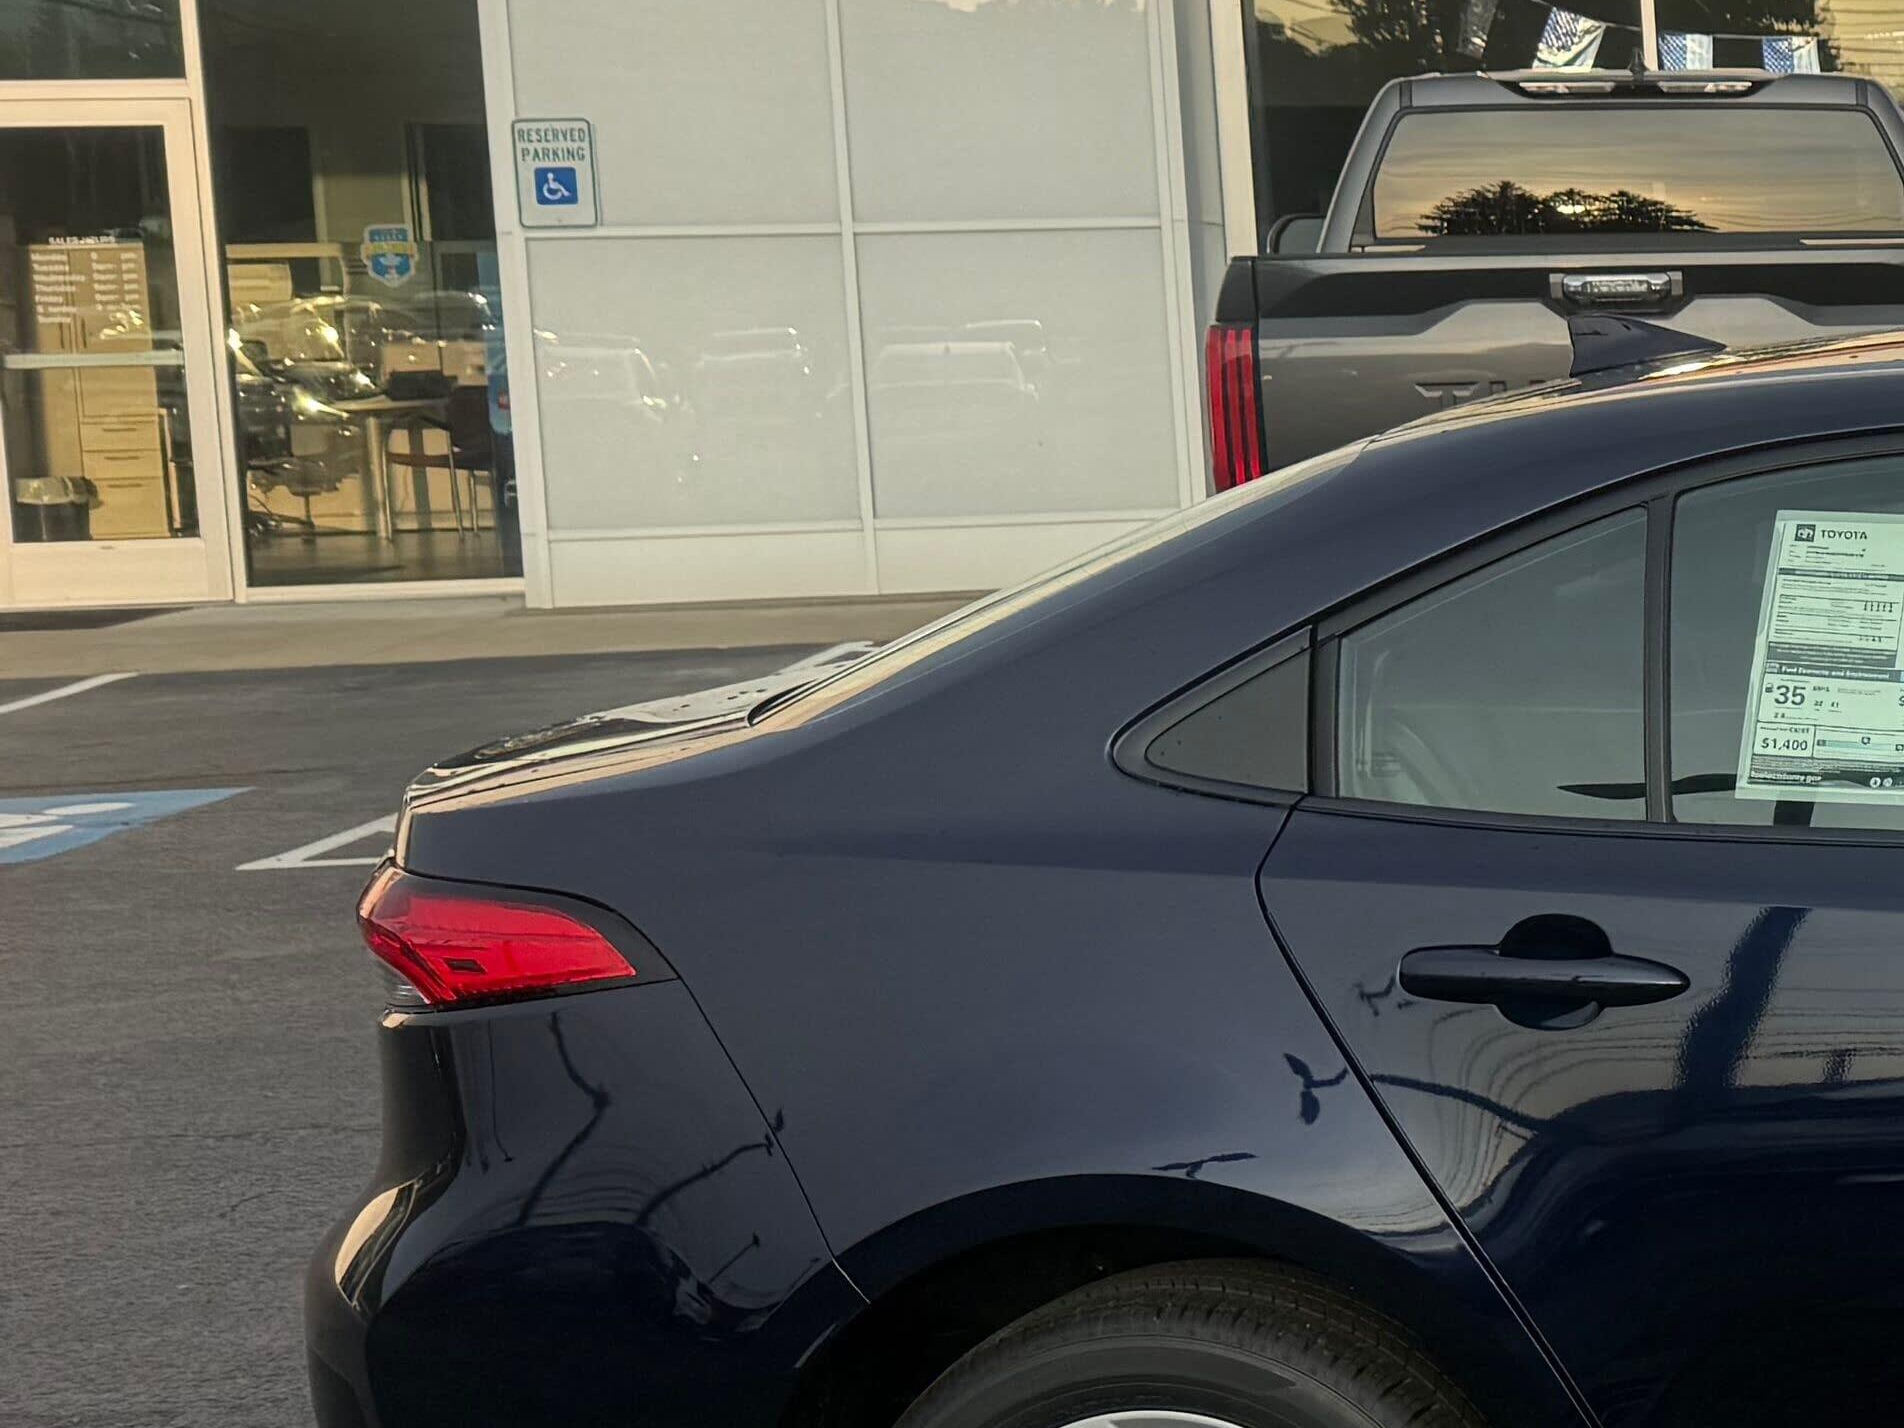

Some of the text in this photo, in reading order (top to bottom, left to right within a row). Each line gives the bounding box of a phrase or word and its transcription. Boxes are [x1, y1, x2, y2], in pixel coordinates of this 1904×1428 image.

[517, 127, 585, 143] RESERVED
[521, 147, 585, 162] PARKING
[1821, 529, 1868, 540] TOYOTA
[1774, 684, 1807, 705] 35
[1761, 737, 1808, 751] $1,400
